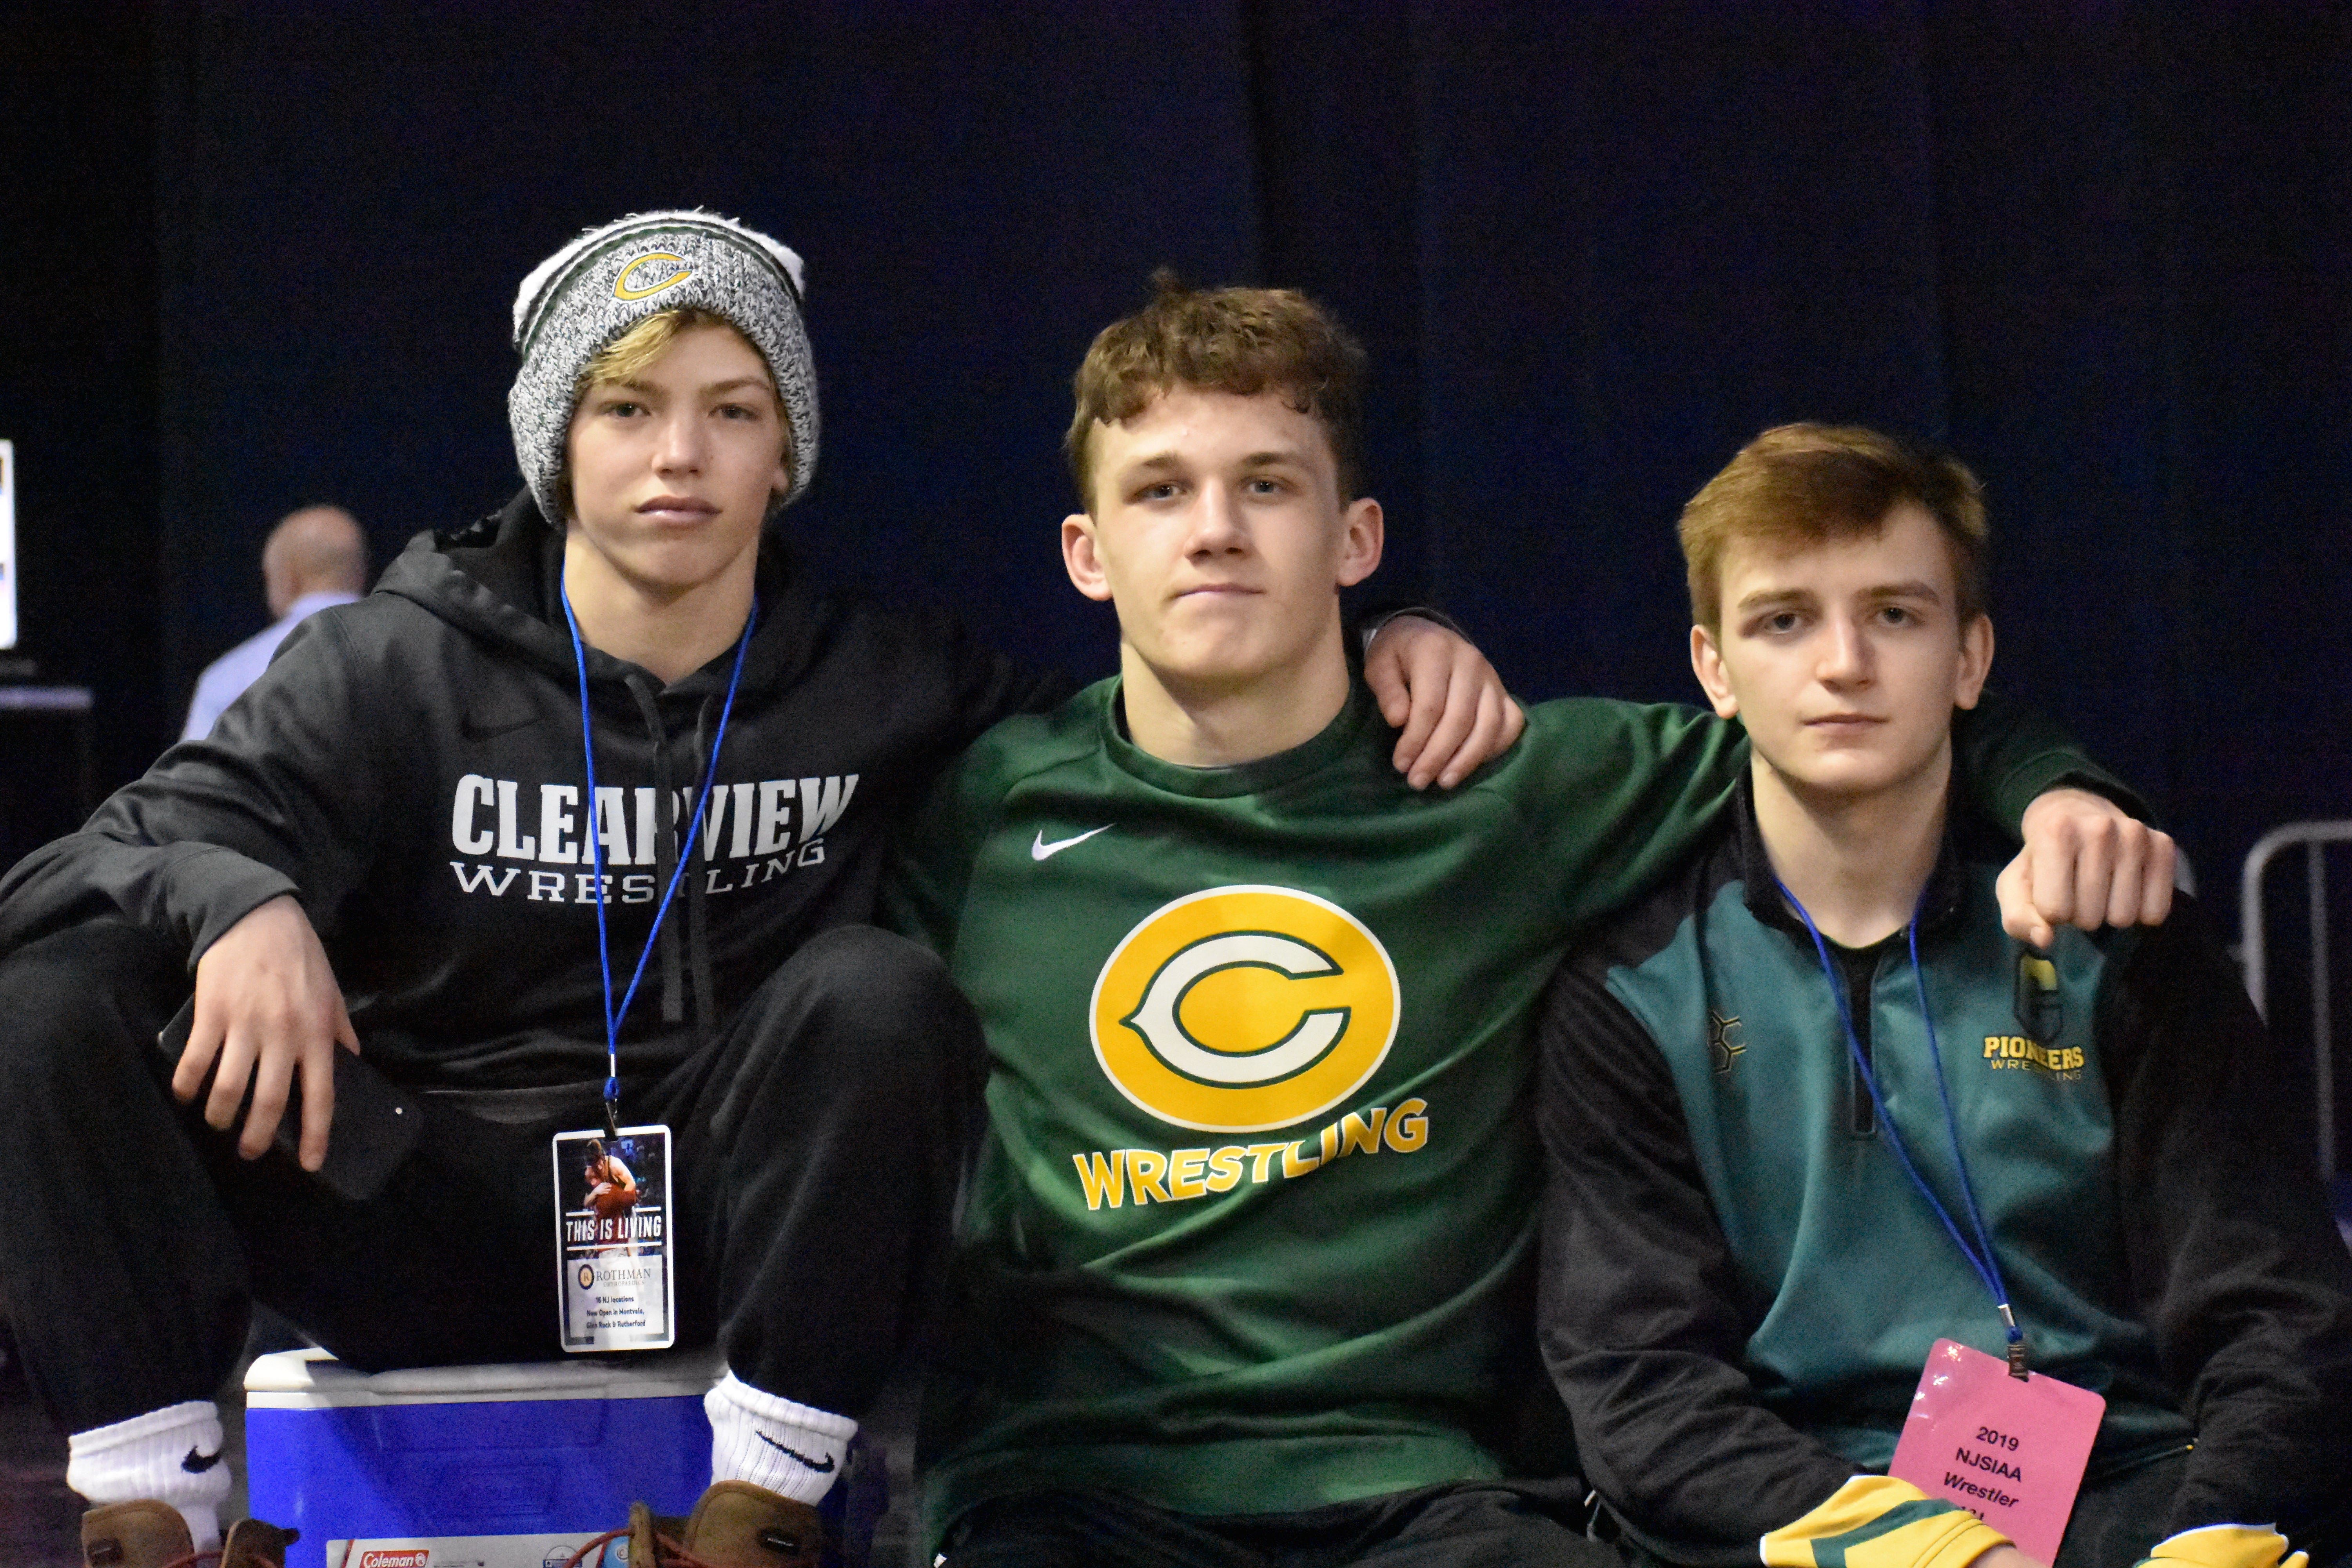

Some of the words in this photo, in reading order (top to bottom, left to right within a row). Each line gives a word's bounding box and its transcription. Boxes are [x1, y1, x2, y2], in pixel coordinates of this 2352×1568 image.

[1073, 1098, 1428, 1210] WRESTLING
[566, 1220, 595, 1242] THIS
[600, 1219, 613, 1240] IS
[618, 1216, 661, 1239] LIVING
[596, 1268, 651, 1281] ROTHMAN
[1976, 1426, 2019, 1451] 2019
[1956, 1447, 2021, 1483] NJSIAA
[1944, 1472, 2019, 1507] Wrestler
[363, 1552, 414, 1568] Coleman
